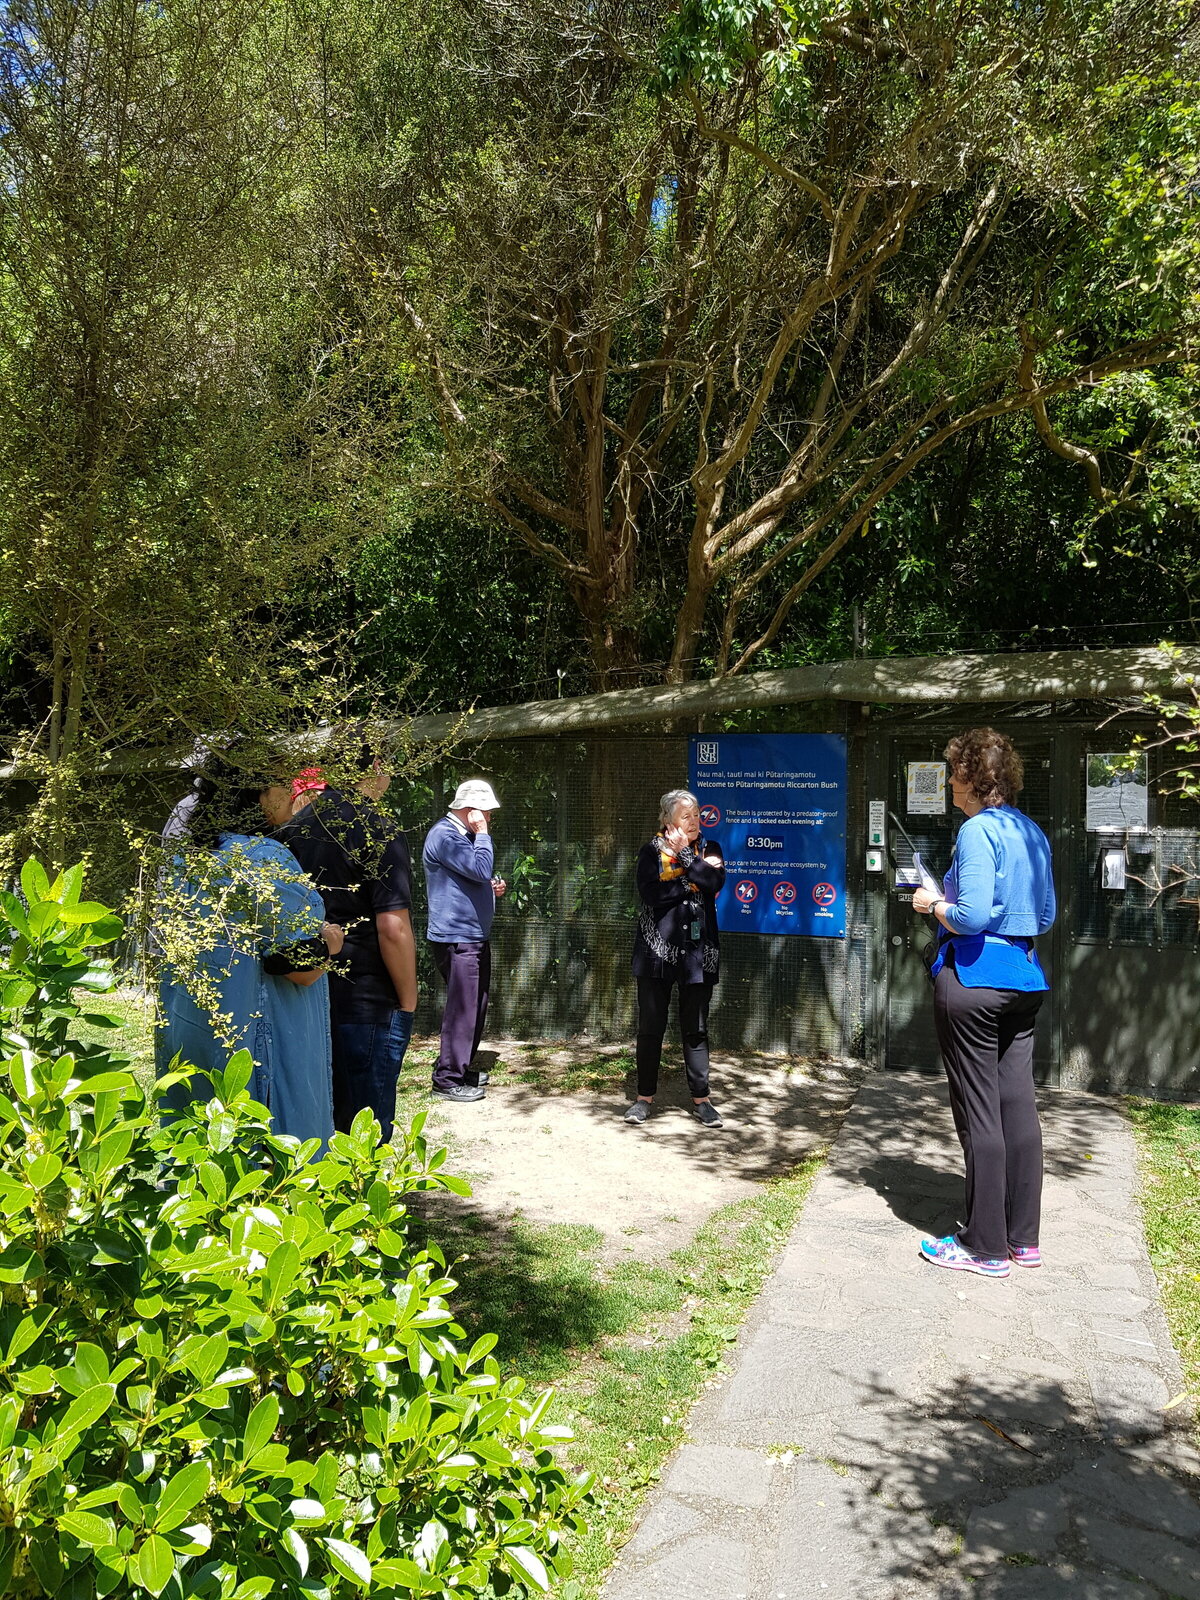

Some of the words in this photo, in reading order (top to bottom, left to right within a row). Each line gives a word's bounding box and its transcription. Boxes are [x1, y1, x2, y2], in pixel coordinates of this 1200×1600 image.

[712, 771, 726, 779] mai,
[747, 837, 783, 849] 8:30pm
[790, 861, 819, 869] ecosystem
[748, 868, 767, 876] simple
